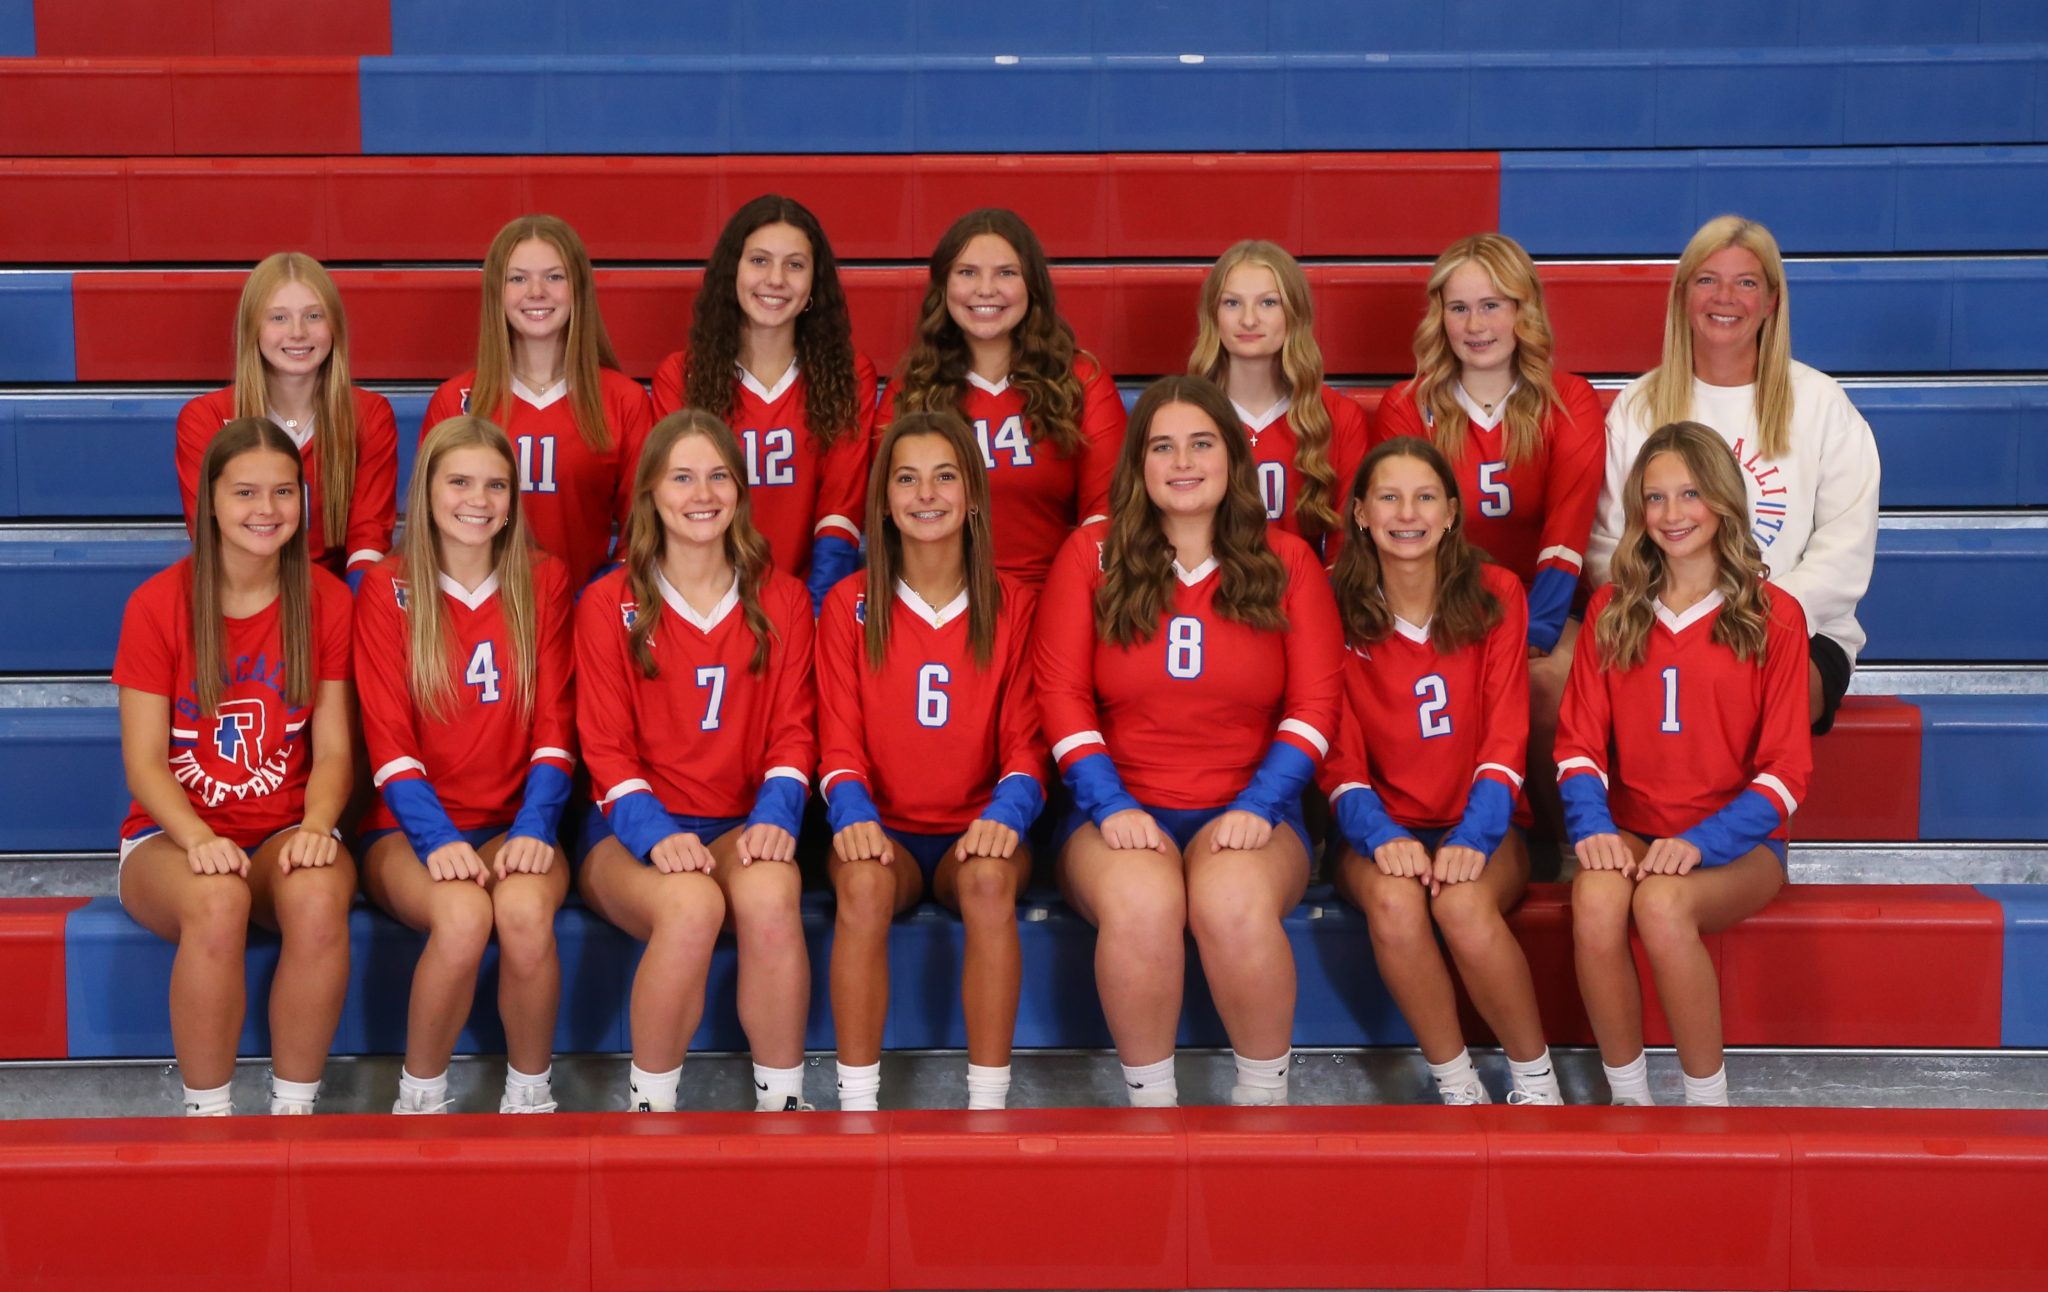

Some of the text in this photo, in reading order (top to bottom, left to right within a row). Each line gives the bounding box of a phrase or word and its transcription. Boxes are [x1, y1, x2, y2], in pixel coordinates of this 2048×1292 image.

[517, 434, 558, 493] 11
[742, 427, 795, 486] 12
[974, 414, 1034, 470] 14
[1479, 460, 1512, 518] 5
[464, 640, 501, 703] 4
[1166, 615, 1204, 679] 8
[696, 665, 726, 731] 7
[917, 662, 950, 727] 6
[1414, 673, 1453, 739] 2
[1660, 666, 1681, 733] 1
